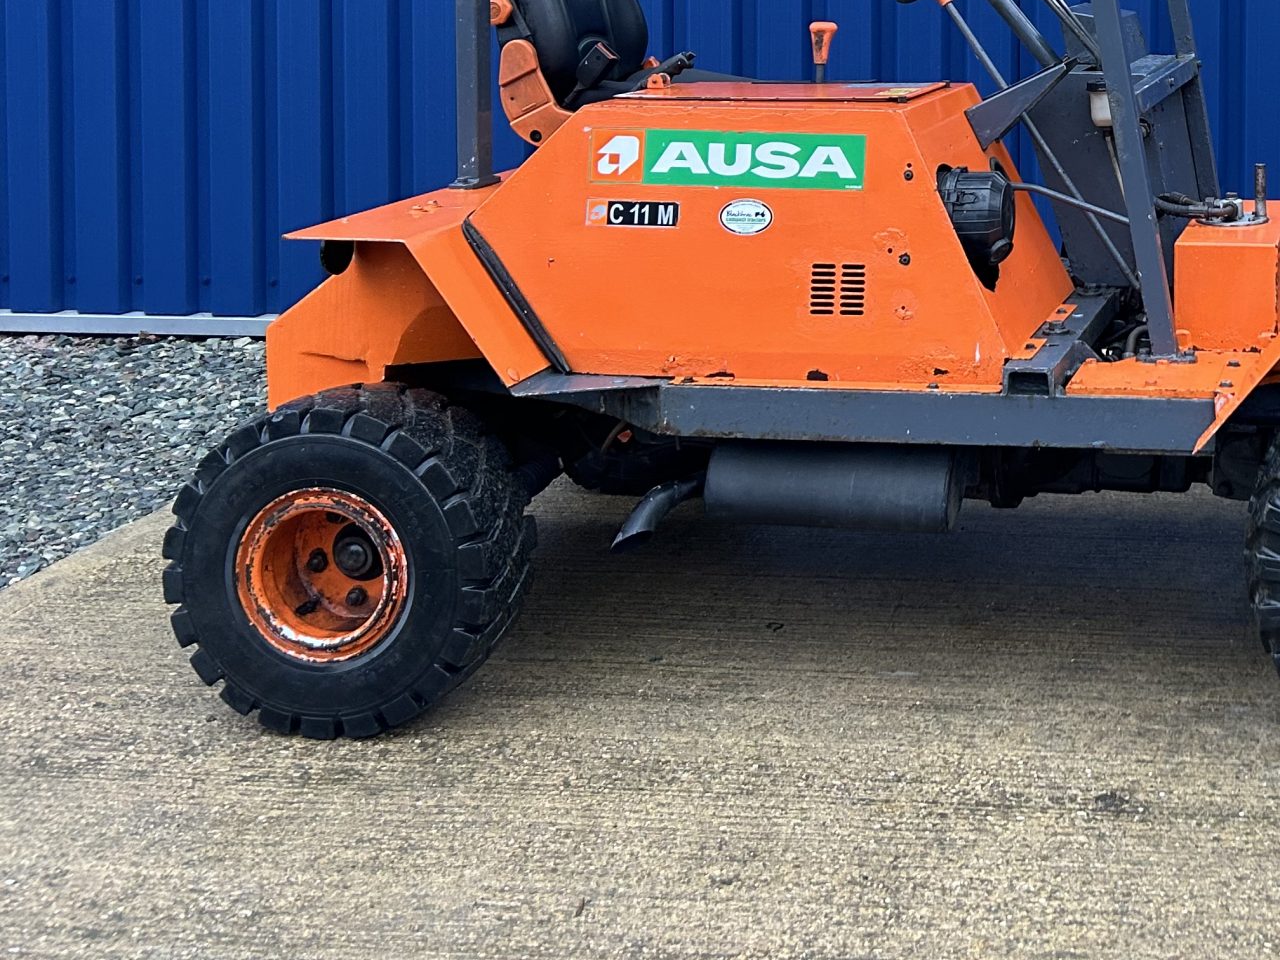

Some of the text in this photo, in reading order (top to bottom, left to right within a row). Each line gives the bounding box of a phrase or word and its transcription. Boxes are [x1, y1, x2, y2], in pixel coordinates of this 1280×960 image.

[650, 141, 857, 179] AUSA
[609, 203, 674, 225] C 11 M
